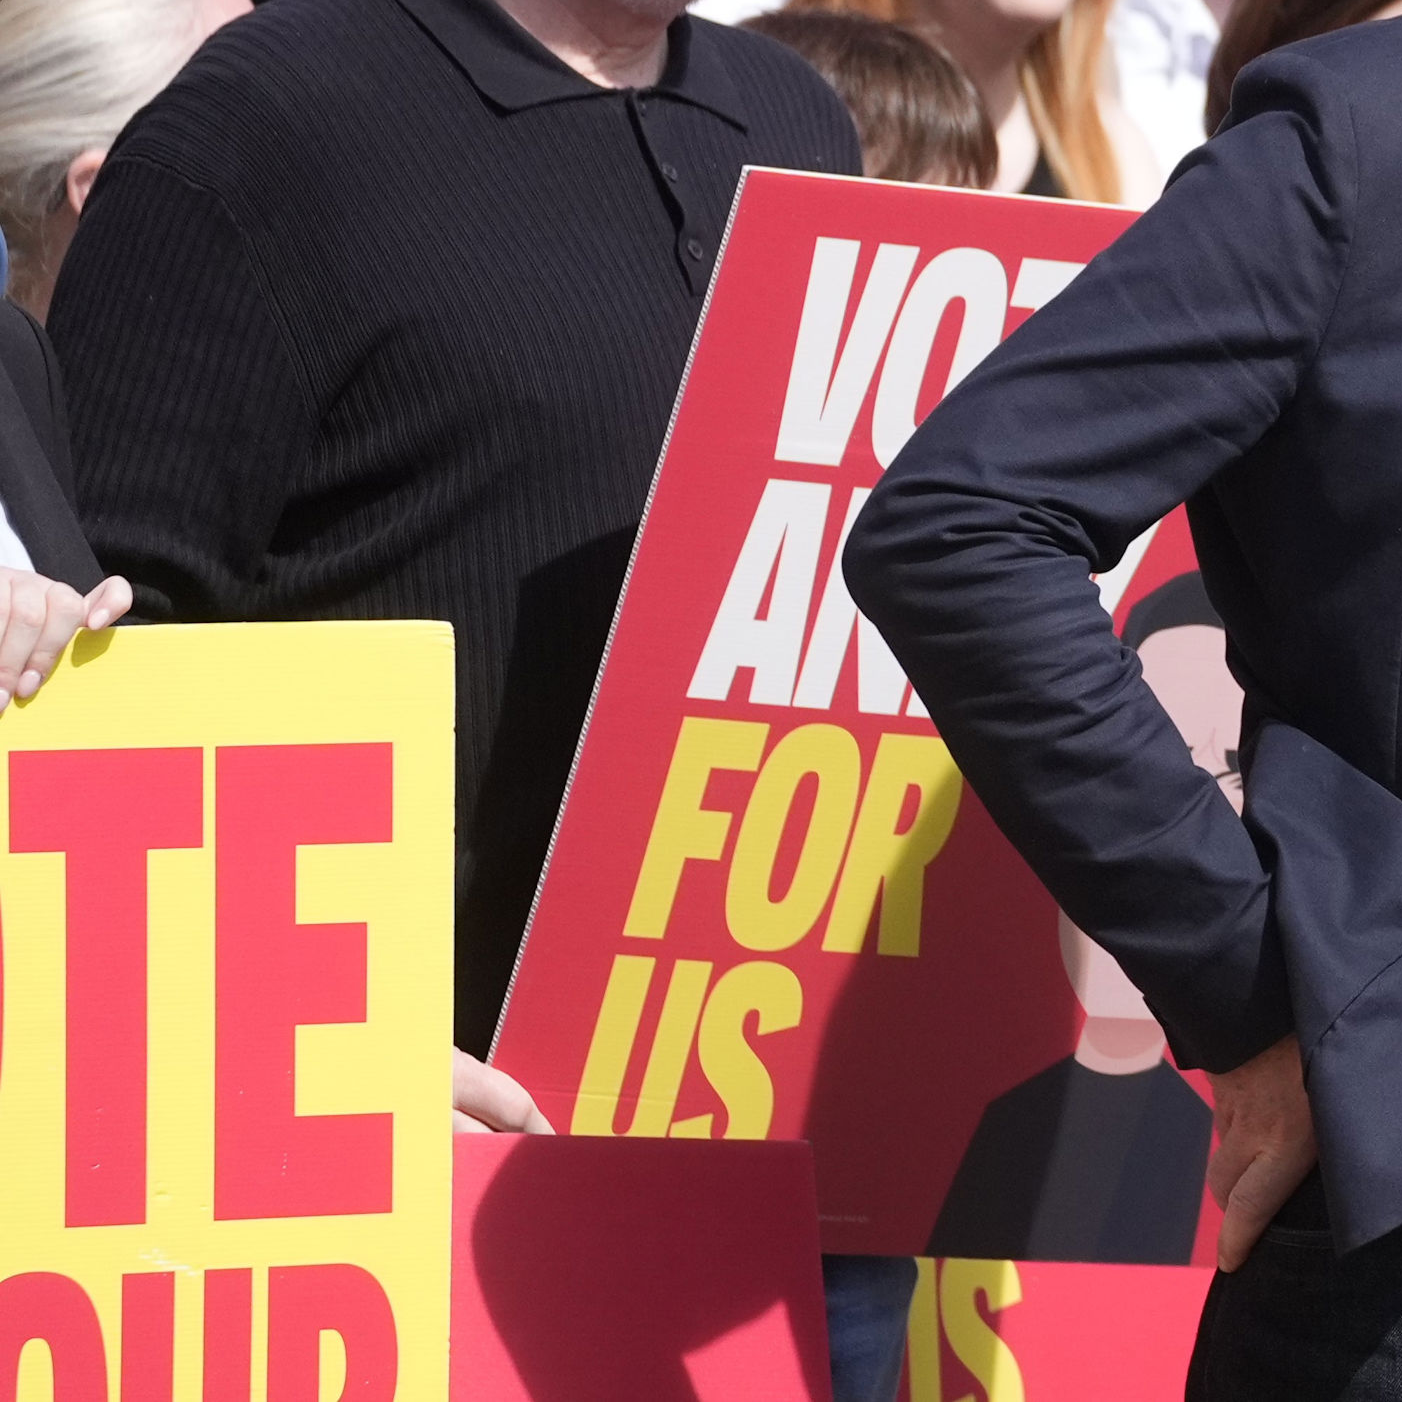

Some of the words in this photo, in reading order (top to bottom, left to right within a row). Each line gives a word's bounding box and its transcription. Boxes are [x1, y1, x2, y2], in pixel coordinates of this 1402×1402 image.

[774, 235, 1090, 470] VO
[623, 716, 963, 957] FOR
[0, 742, 393, 1229] TE
[570, 954, 803, 1141] US
